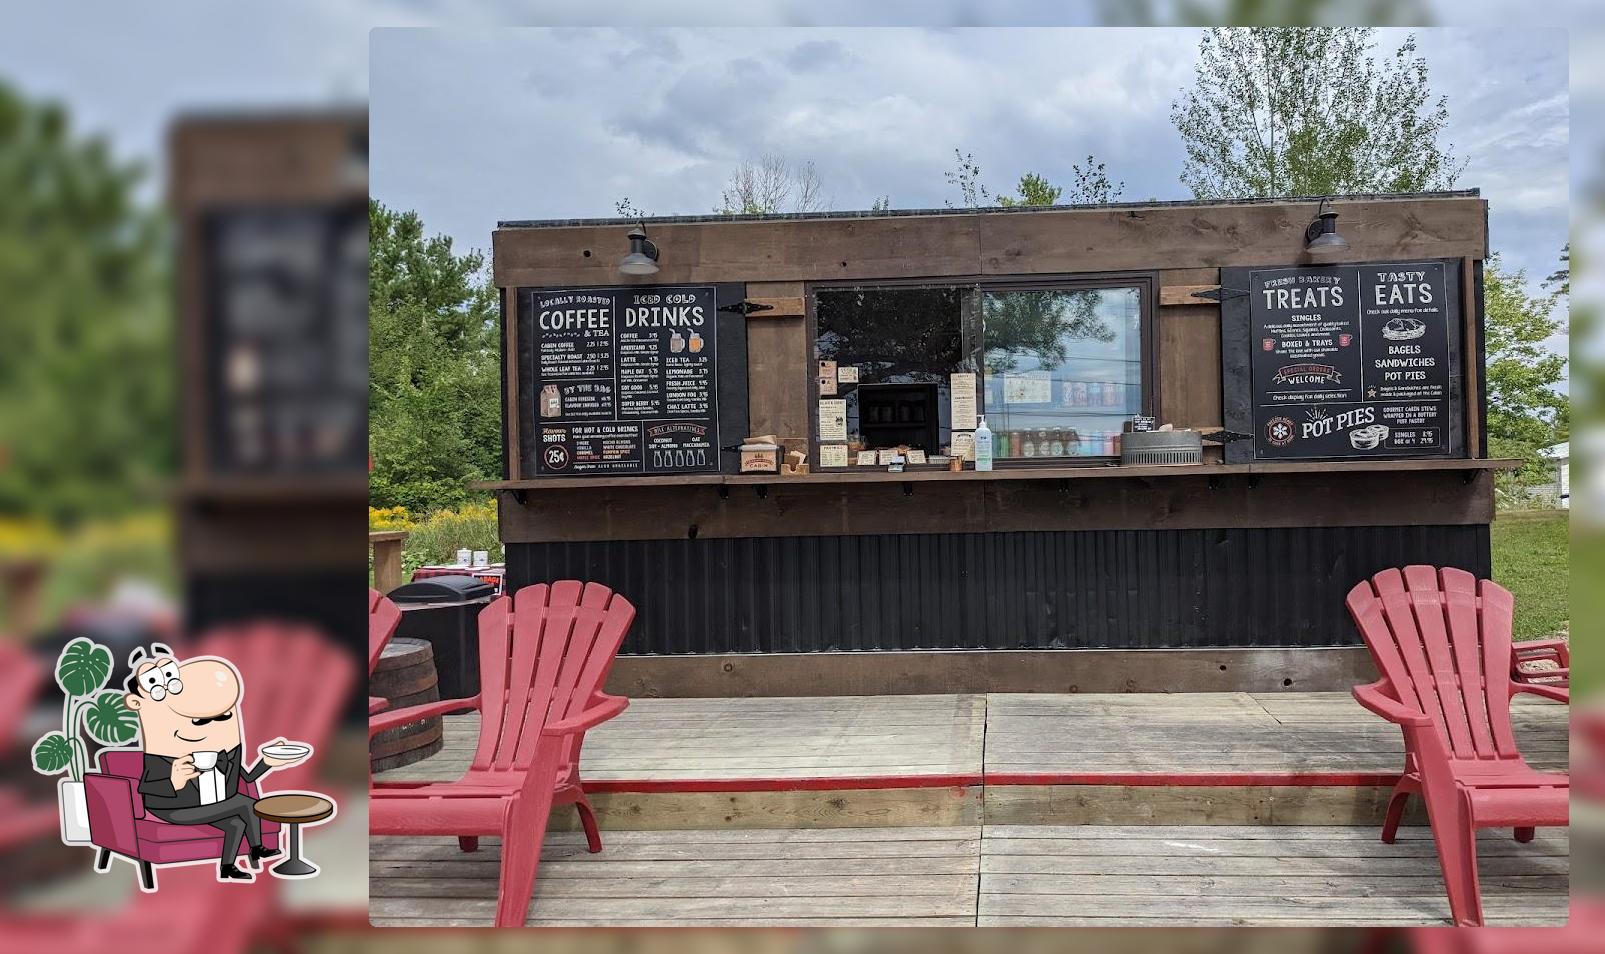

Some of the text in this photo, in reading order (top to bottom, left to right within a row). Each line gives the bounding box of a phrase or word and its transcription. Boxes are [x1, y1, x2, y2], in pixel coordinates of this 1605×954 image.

[1264, 276, 1340, 288] FRESH BAKERY
[1378, 271, 1425, 282] TASTY
[634, 294, 696, 304] ICED COLD
[1263, 286, 1343, 309] TREATS
[1375, 283, 1432, 305] EATS
[540, 296, 610, 308] LOCALLY ROASTED
[540, 309, 609, 330] COFFEE
[626, 306, 704, 327] DRINKS
[1388, 345, 1421, 354] BAGELS
[1375, 357, 1435, 368] SANDWICHES
[1385, 371, 1426, 380] POT PIES
[1301, 407, 1375, 439] POT PIES
[543, 435, 566, 443] SHOTS
[548, 450, 565, 464] 25¢
